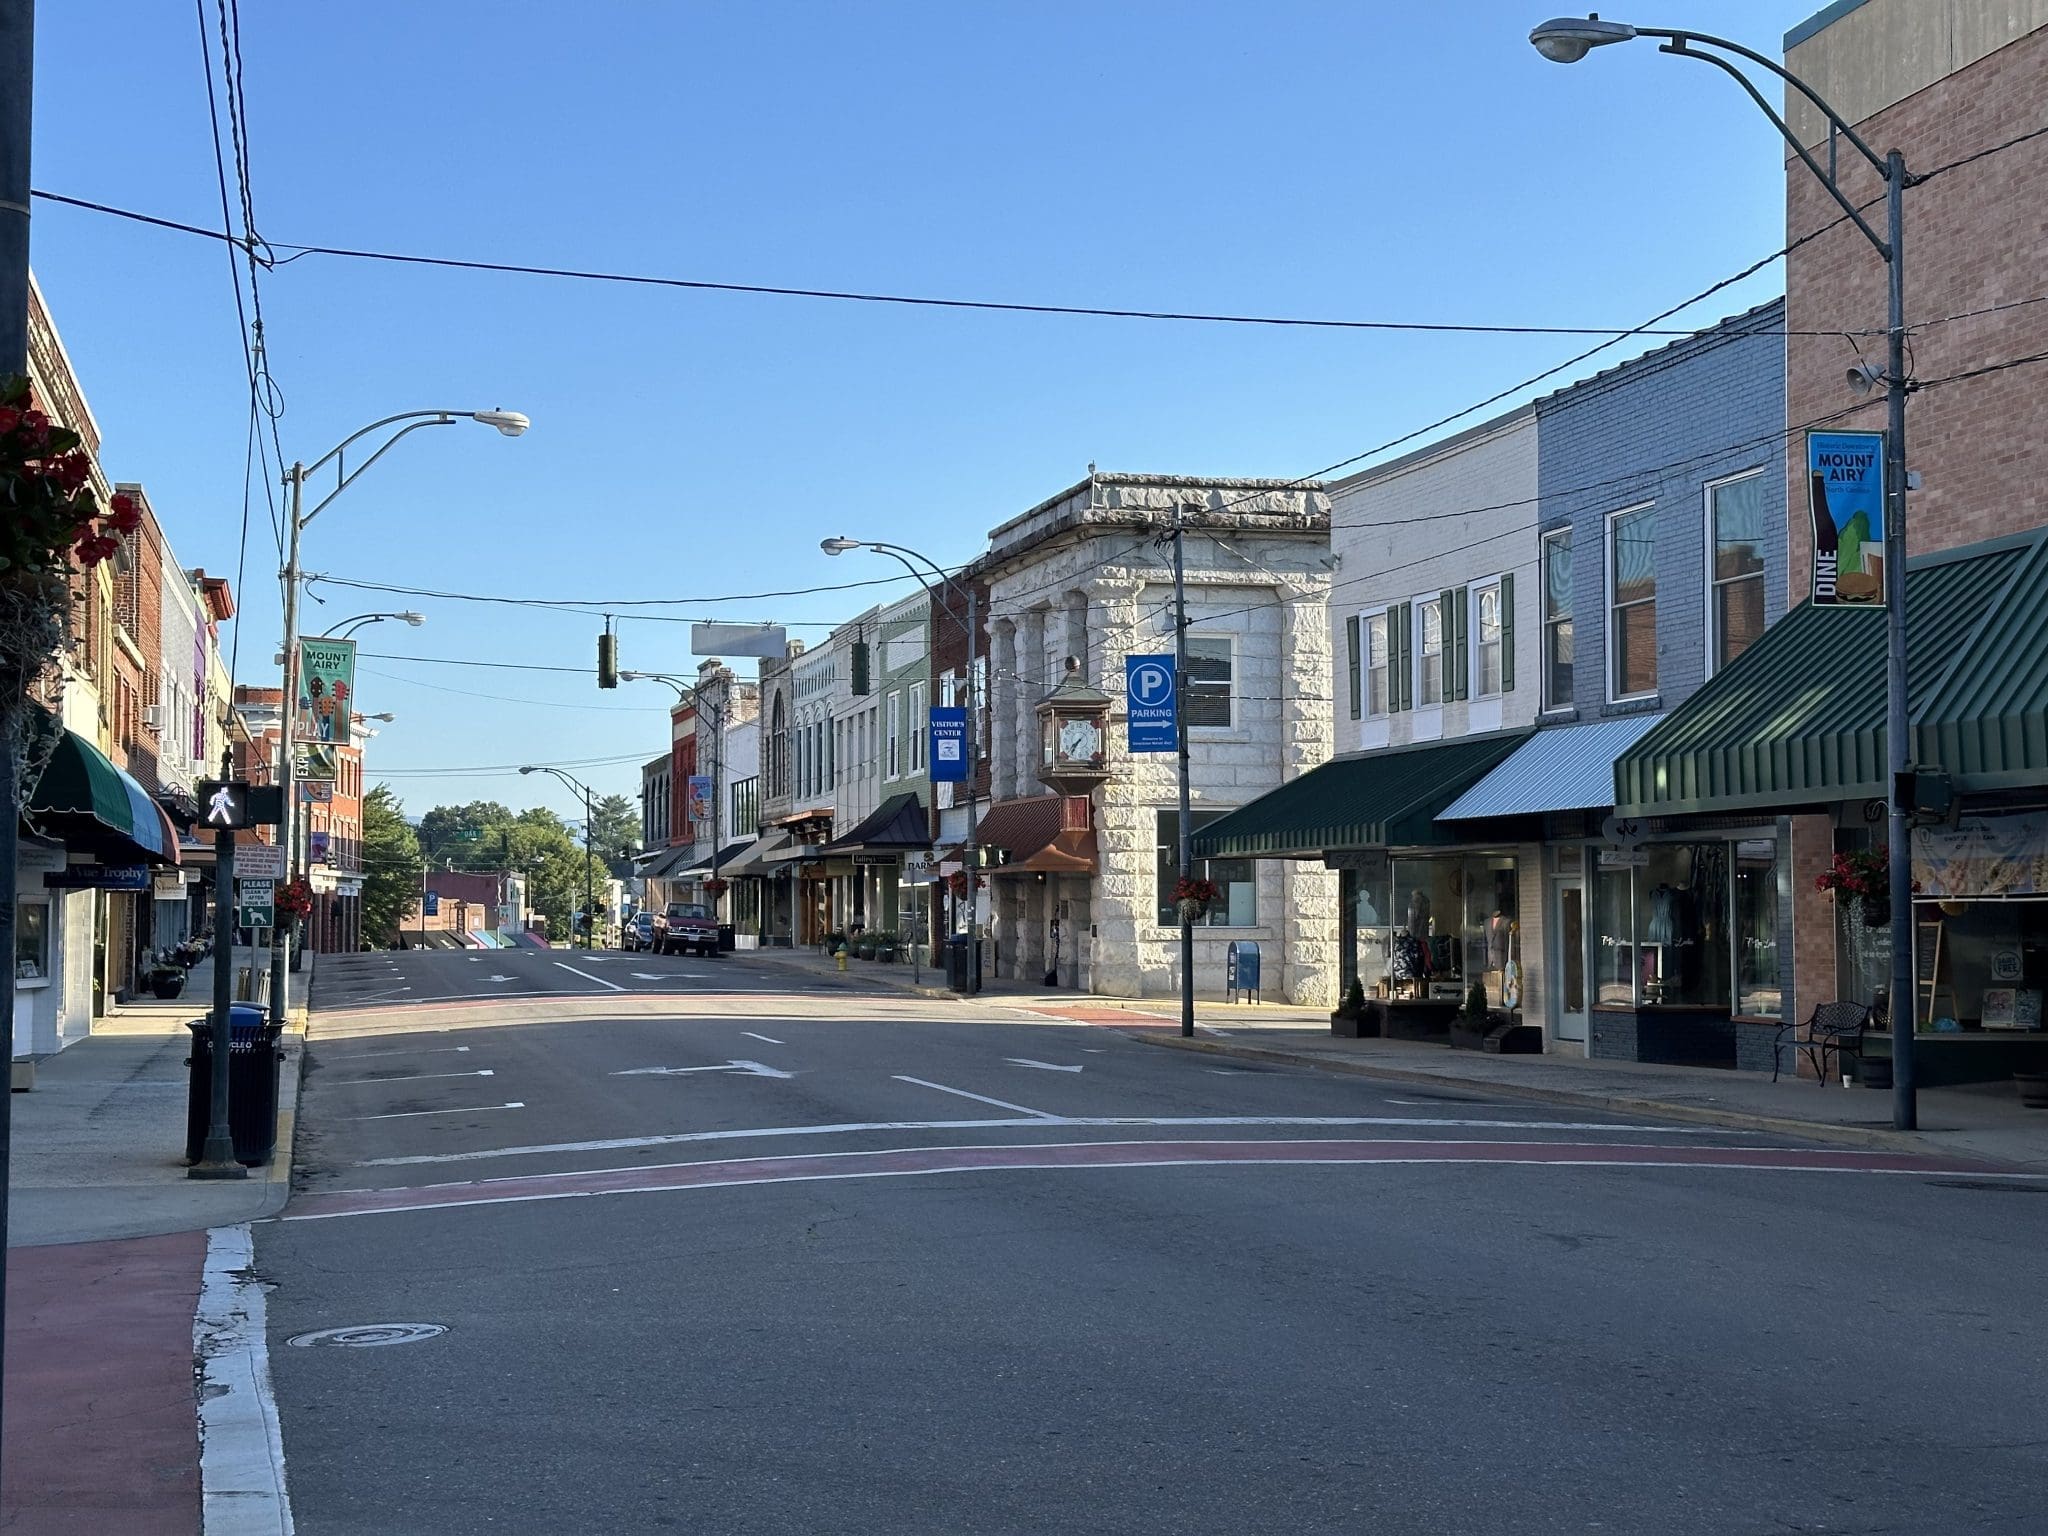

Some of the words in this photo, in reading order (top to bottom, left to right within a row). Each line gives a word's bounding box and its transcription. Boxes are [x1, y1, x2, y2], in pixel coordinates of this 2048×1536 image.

[1818, 454, 1874, 468] MOUNT
[1829, 468, 1866, 481] AIRY
[1815, 549, 1837, 597] DINE
[306, 651, 348, 662] MOUNT
[313, 661, 340, 670] AIRY
[1141, 670, 1163, 698] P
[1131, 709, 1172, 718] PARKING
[297, 722, 329, 737] PLAY
[934, 729, 962, 737] CENTER
[321, 782, 331, 799] CRE
[103, 866, 145, 880] Trophy
[243, 880, 271, 888] PLEASE
